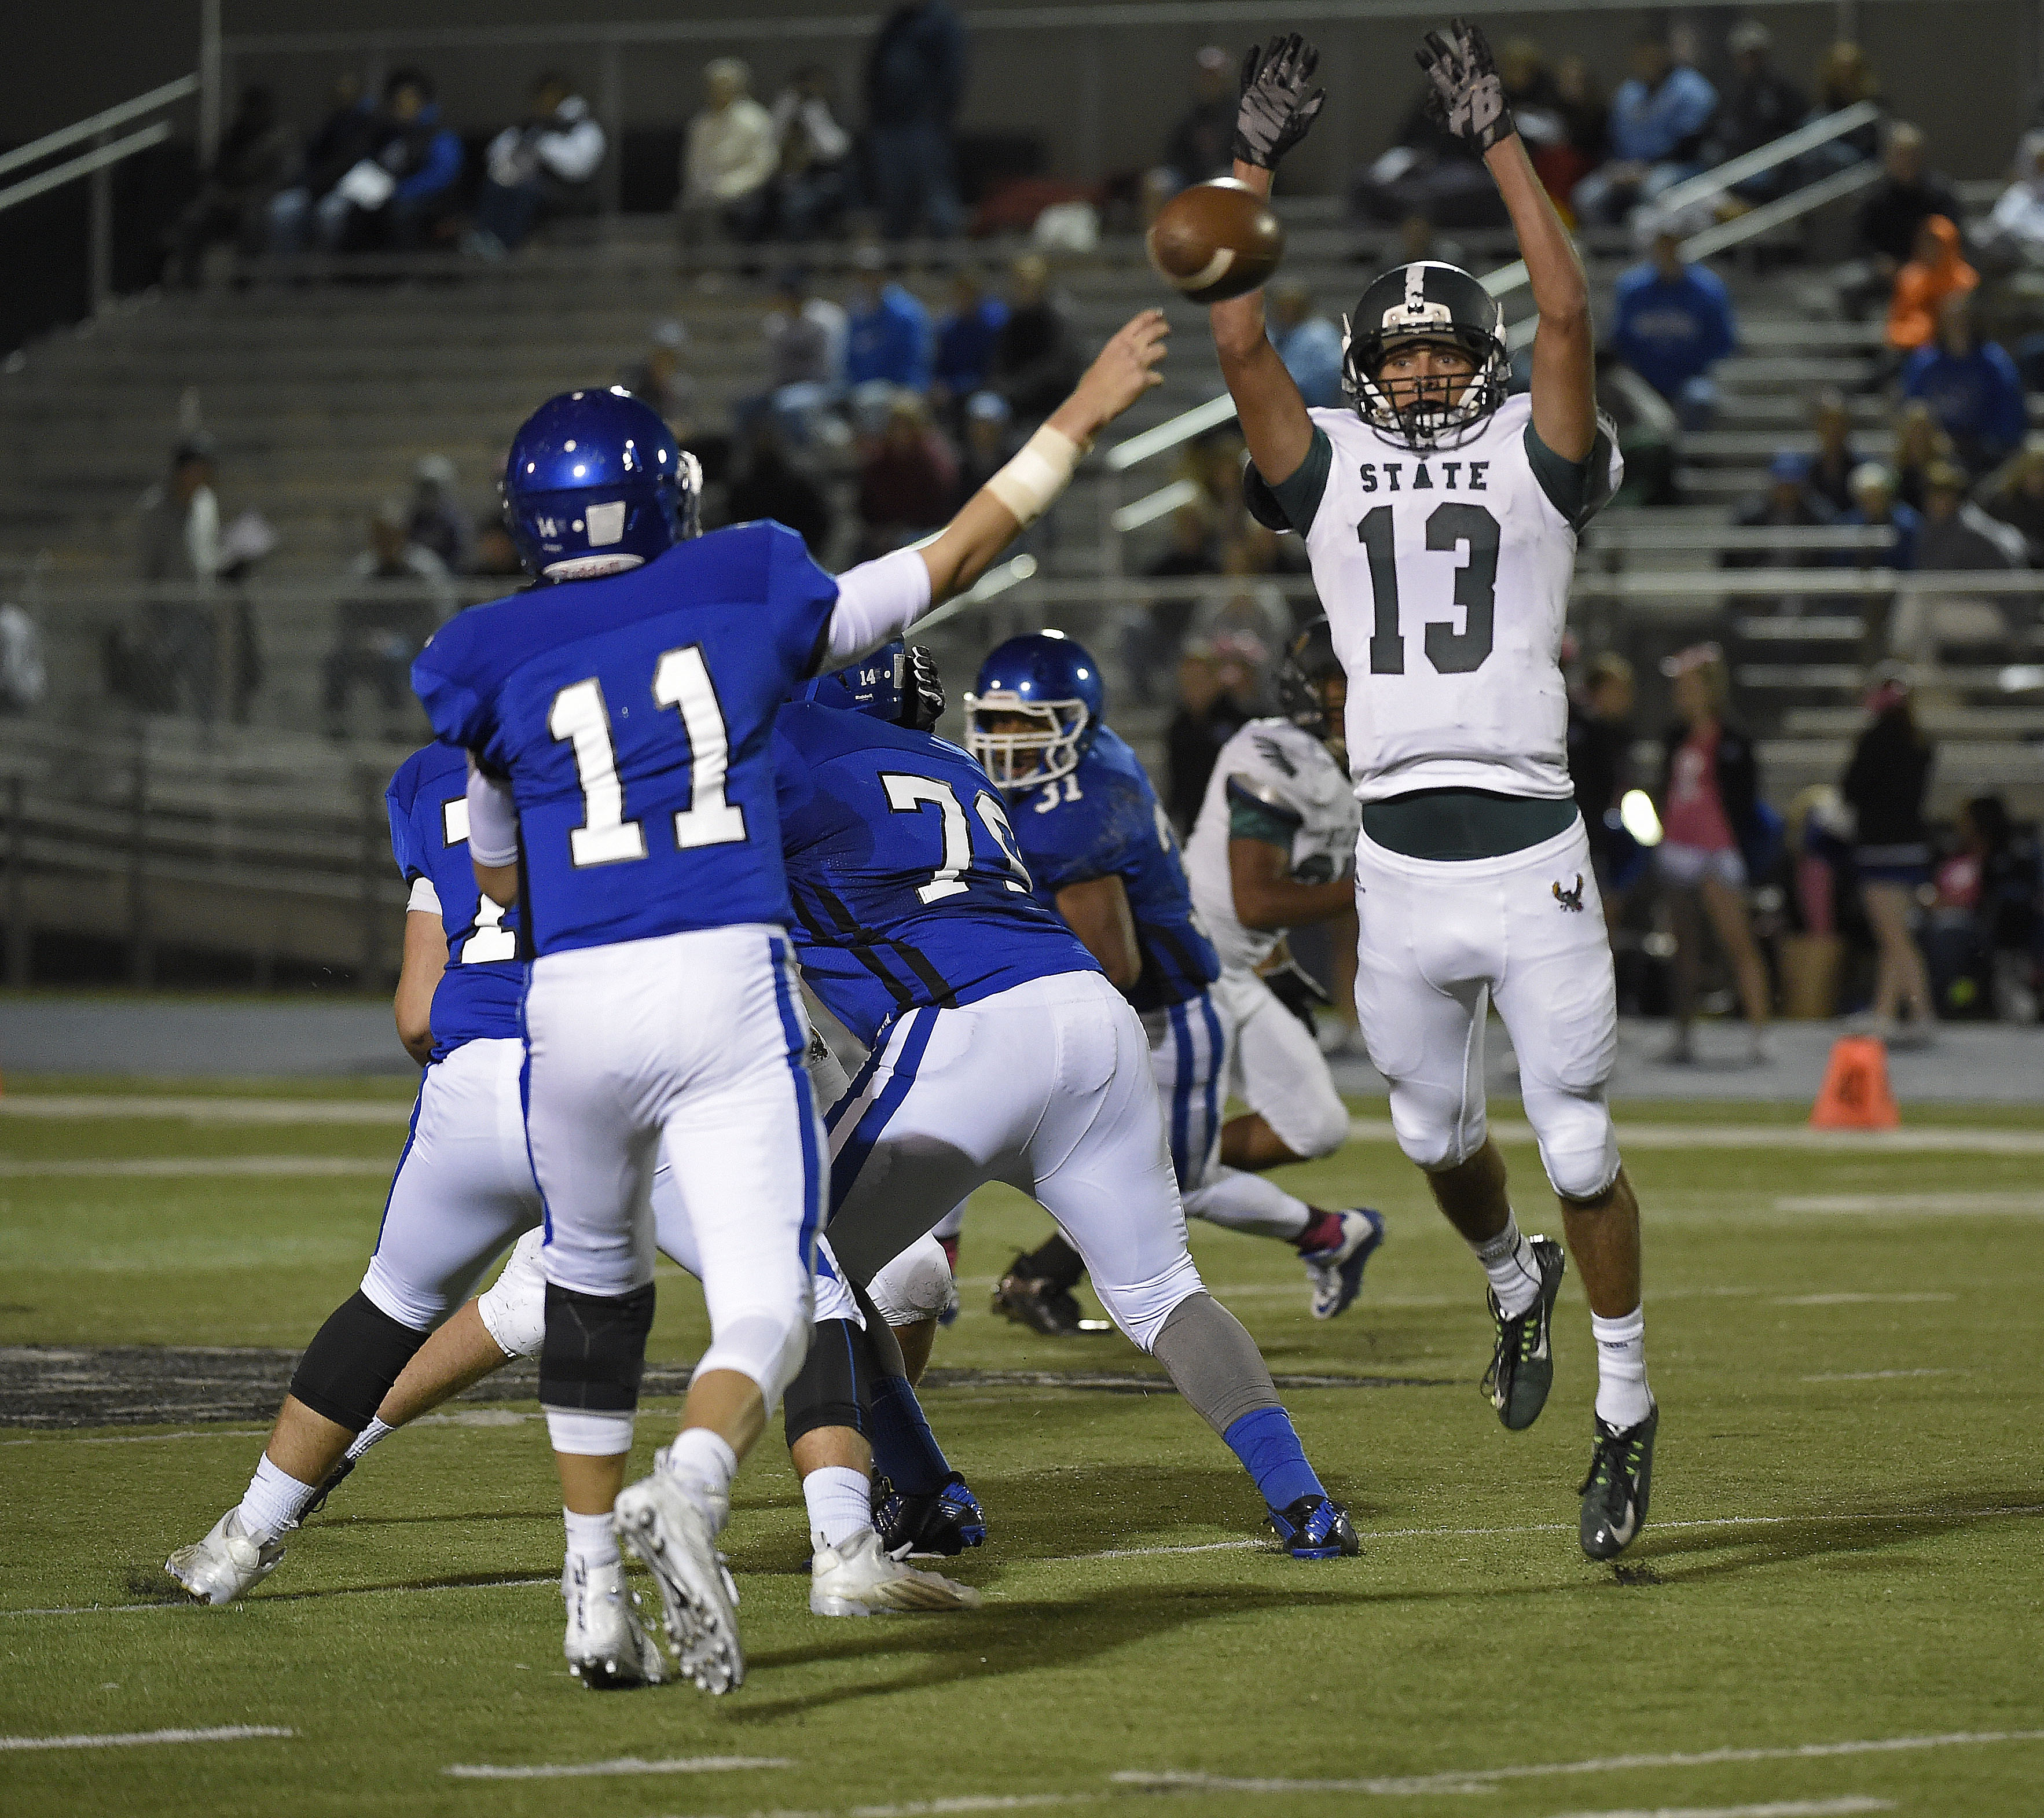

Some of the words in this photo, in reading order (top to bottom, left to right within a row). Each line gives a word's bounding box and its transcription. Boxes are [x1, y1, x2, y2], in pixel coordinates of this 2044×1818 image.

[1360, 461, 1490, 492] STATE
[1356, 502, 1502, 675] 13
[860, 668, 876, 686] 14
[546, 641, 748, 868] 11
